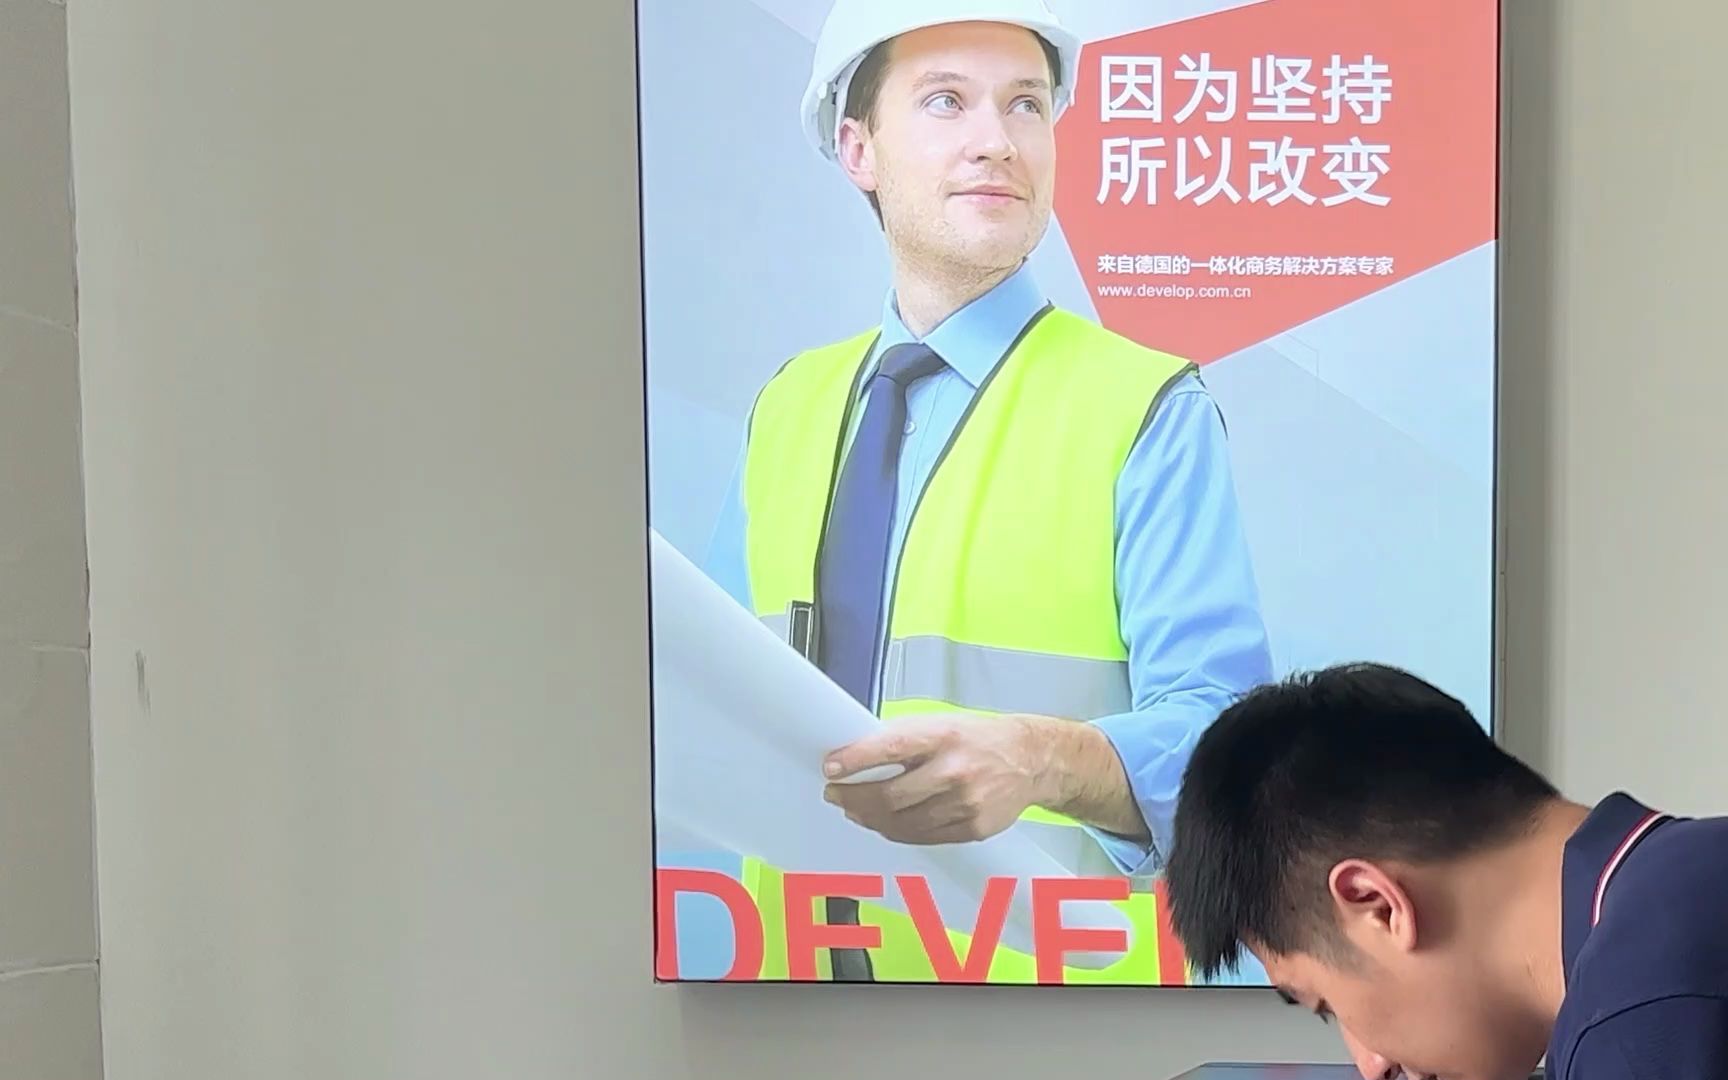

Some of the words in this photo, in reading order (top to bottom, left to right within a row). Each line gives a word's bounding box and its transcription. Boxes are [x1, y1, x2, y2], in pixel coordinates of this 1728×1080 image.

[1100, 53, 1393, 125] 因为坚持
[1096, 136, 1392, 207] 所以改变
[1097, 254, 1394, 276] 来自德国的一体化商务解决方案专家
[1097, 284, 1252, 300] www.develop.com.cn
